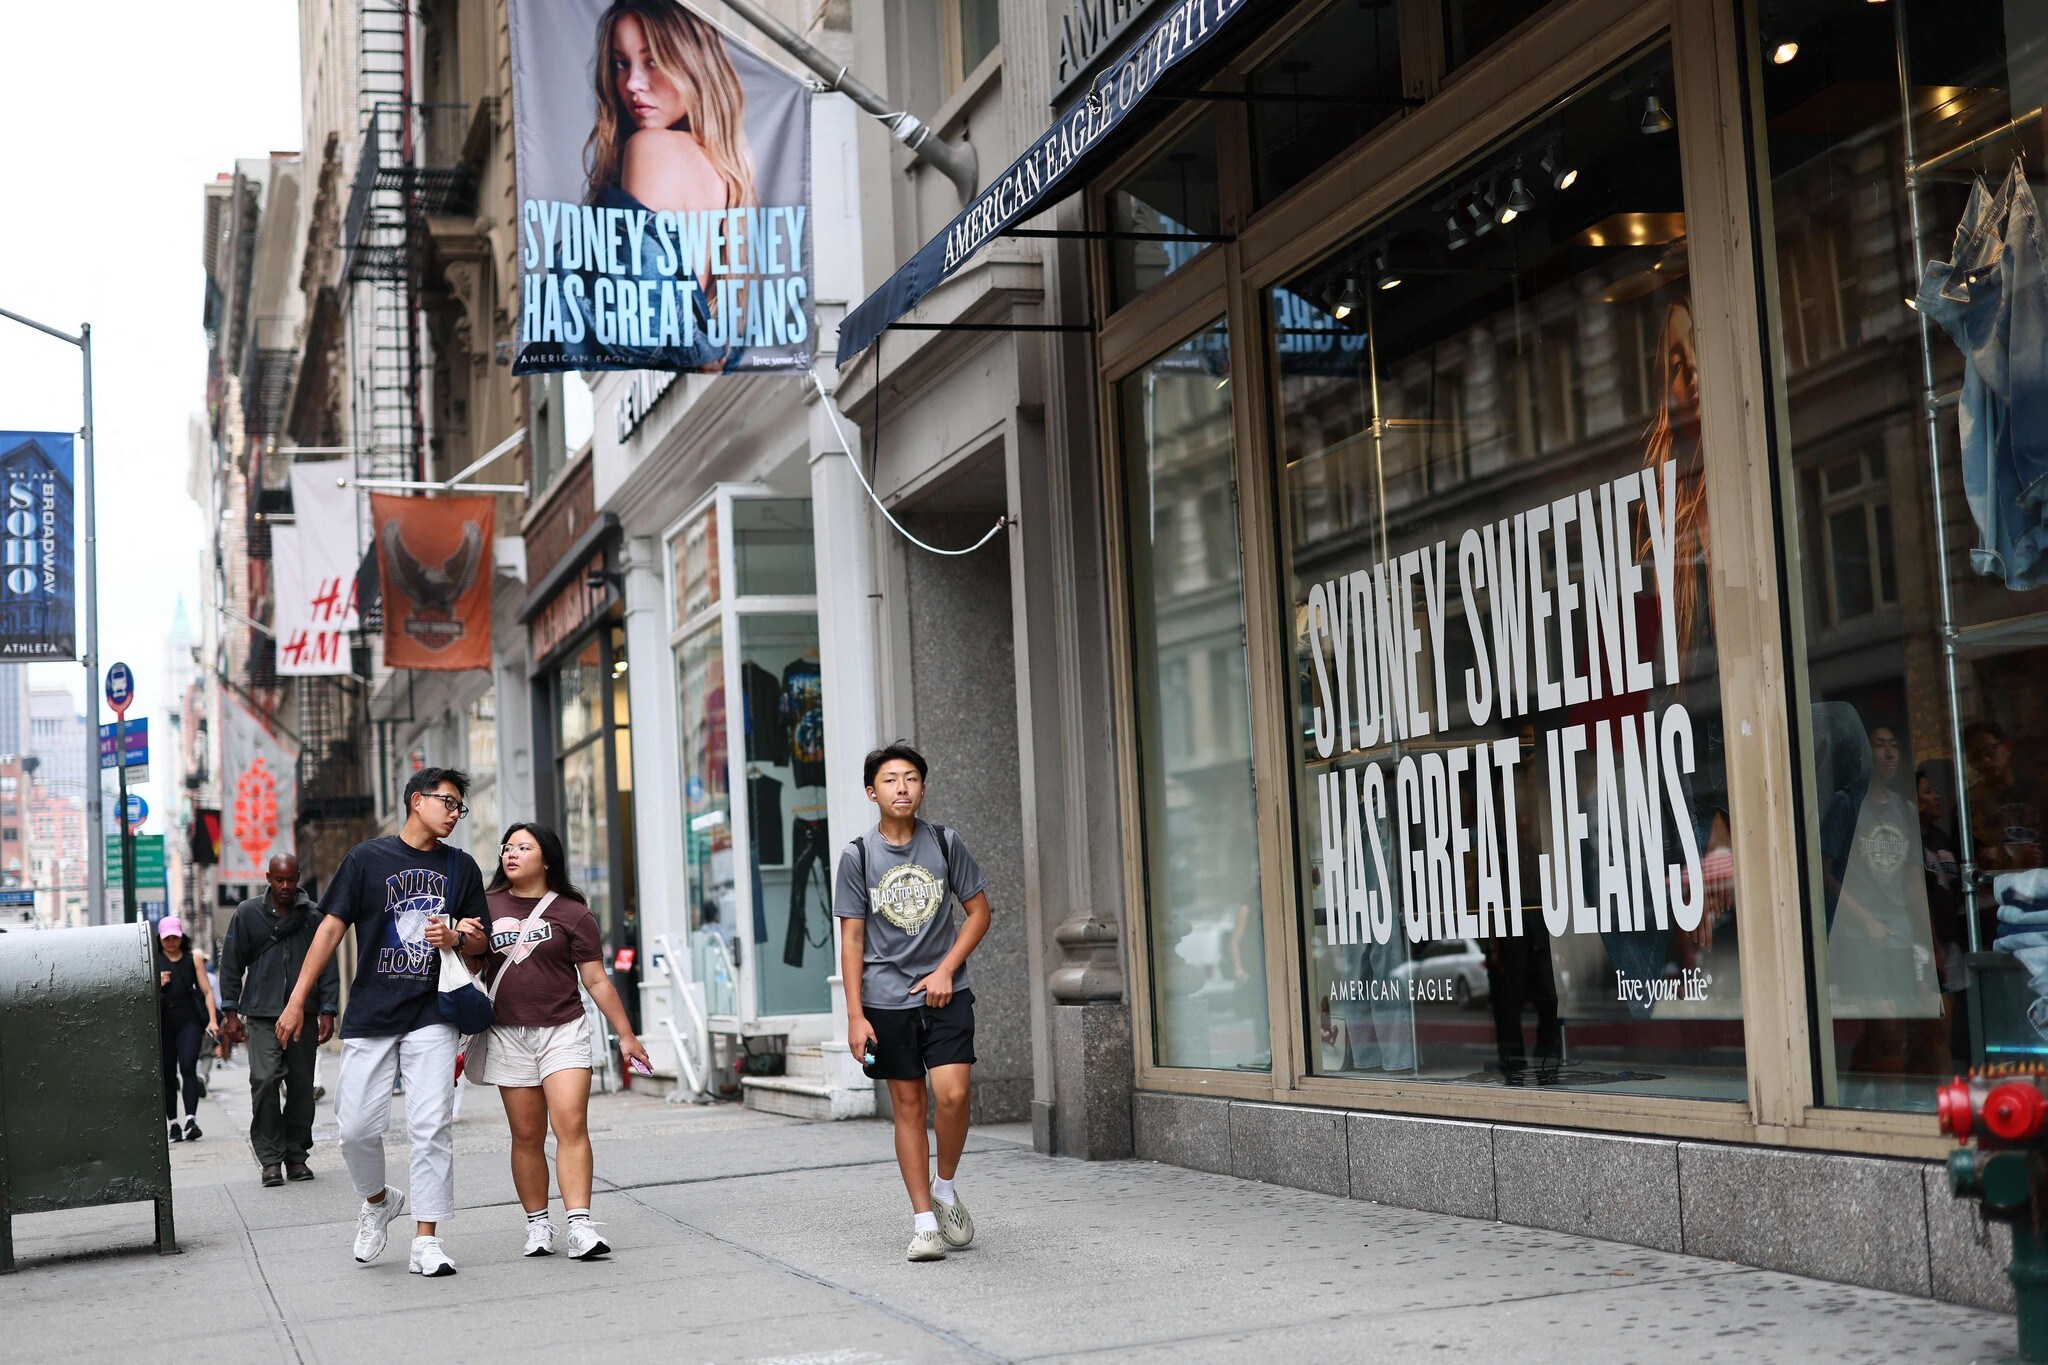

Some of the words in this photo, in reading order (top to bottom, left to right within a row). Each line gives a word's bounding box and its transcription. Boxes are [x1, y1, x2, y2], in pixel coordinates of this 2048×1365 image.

[943, 149, 1041, 273] AMERICAN
[1044, 80, 1113, 185] EAGLE
[1117, 0, 1238, 110] OUTFIT
[523, 199, 648, 276] SYDNEY
[654, 205, 806, 276] SWEENEY
[522, 273, 586, 344] HAS
[594, 277, 698, 347] GREAT
[707, 276, 808, 347] JEANS
[520, 354, 589, 364] AMERICAN
[595, 355, 634, 364] EAGLE
[6, 481, 38, 595] SOHO
[42, 483, 55, 594] BROADWAY
[1308, 540, 1449, 759] SYDNEY
[1458, 459, 1680, 727] SWEENEY
[3, 643, 58, 653] ATHLETA
[1318, 762, 1393, 946] HAS
[1398, 737, 1524, 944] GREAT
[1539, 703, 1704, 938] JEANS
[869, 886, 912, 914] BLACKTOP
[914, 879, 944, 903] BATTLE
[1330, 979, 1400, 1001] AMERICAN
[1408, 978, 1453, 1001] EAGLE
[1615, 969, 1644, 1001] live
[1643, 979, 1681, 1009] your
